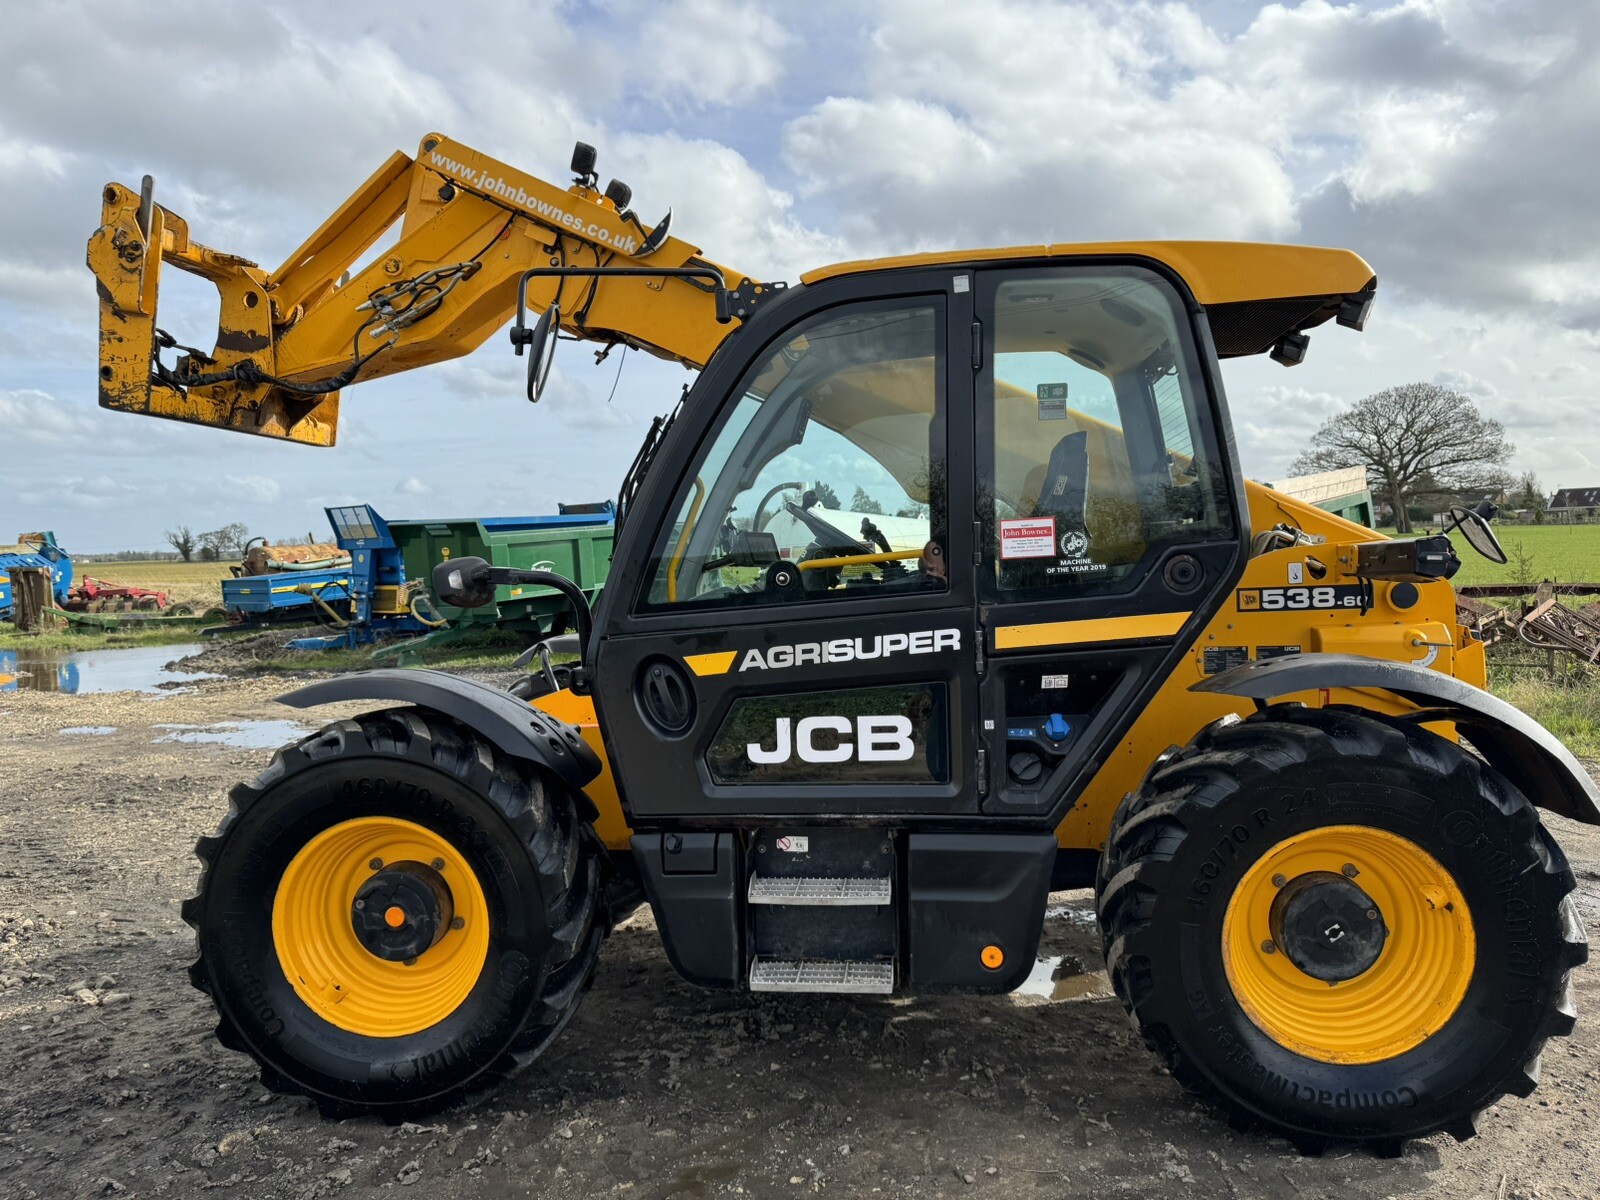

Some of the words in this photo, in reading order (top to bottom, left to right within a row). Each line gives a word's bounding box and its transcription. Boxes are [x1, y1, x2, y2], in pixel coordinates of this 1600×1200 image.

[431, 150, 638, 253] www.johnbownes.co.uk
[1003, 529, 1020, 539] John
[1060, 558, 1092, 566] MACHINE
[1090, 563, 1107, 571] 2019
[738, 628, 961, 672] AGRISUPER
[747, 715, 915, 764] JCB
